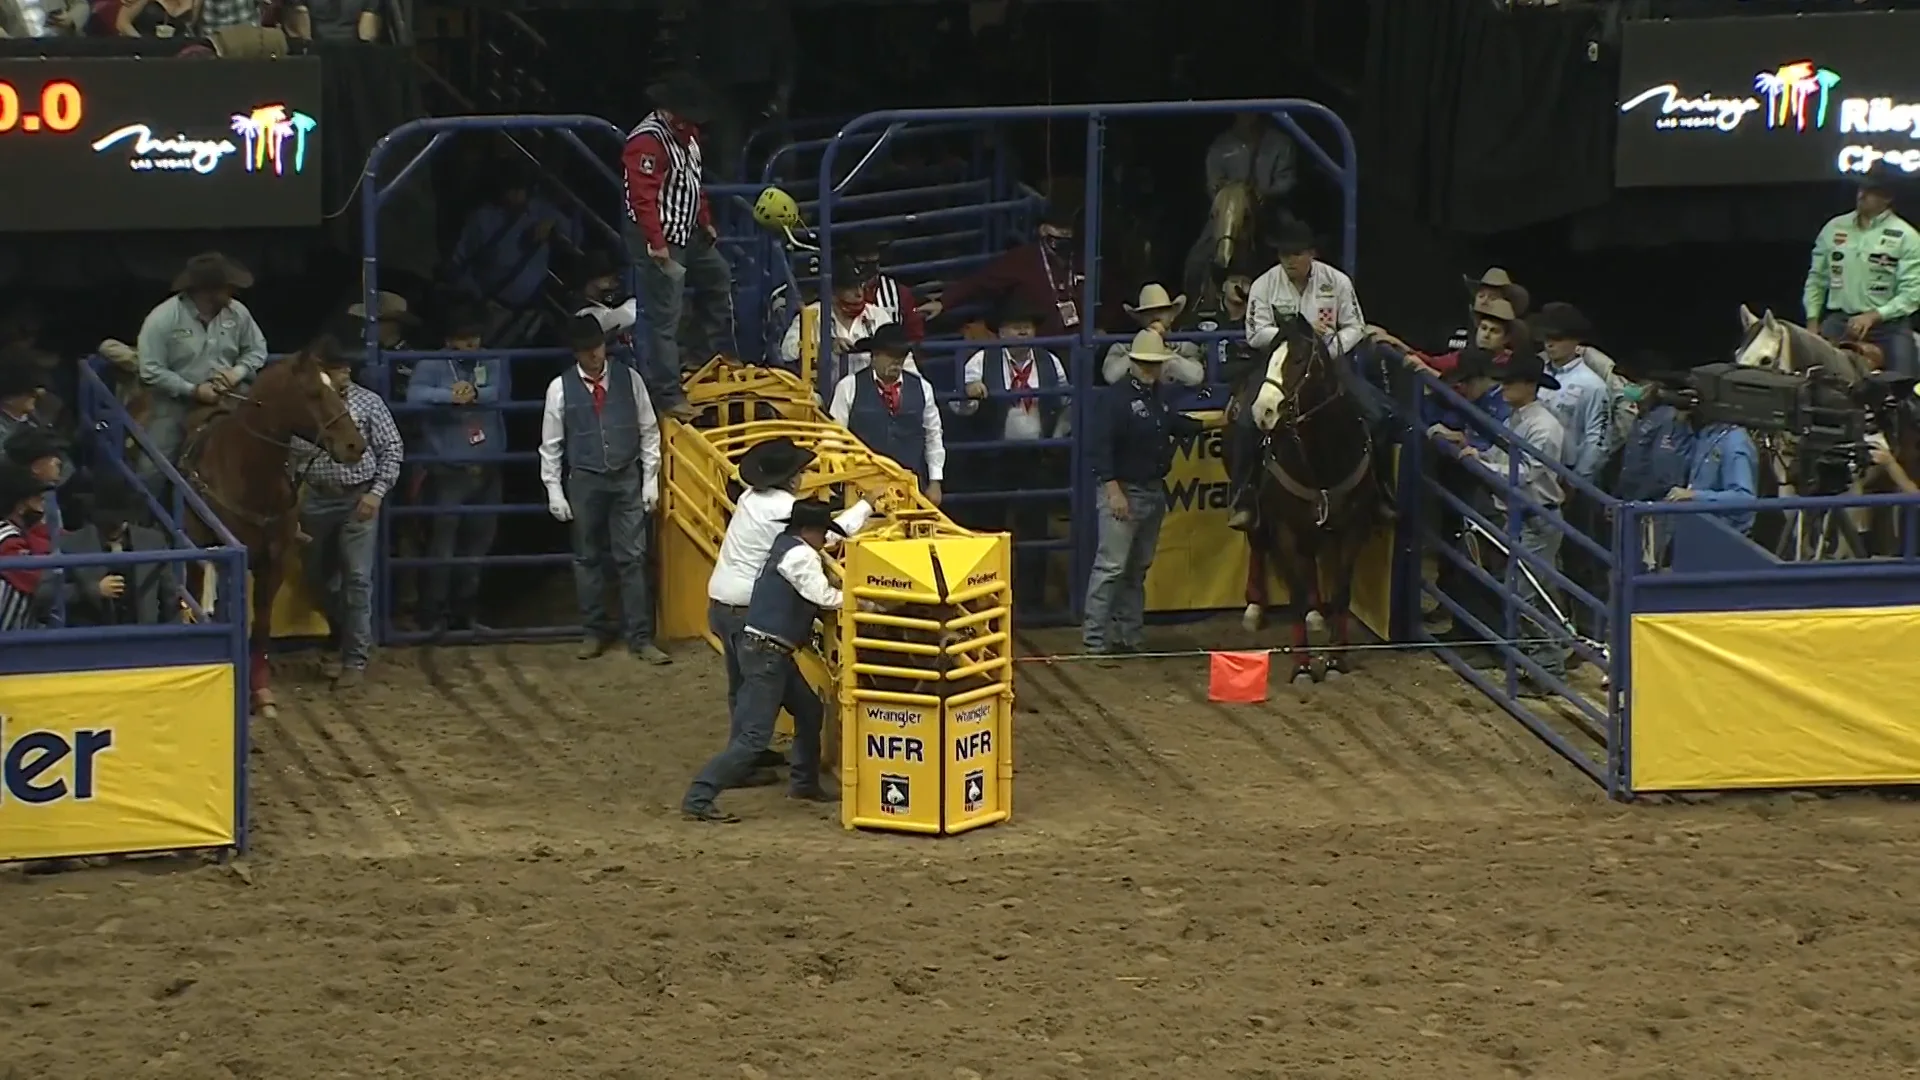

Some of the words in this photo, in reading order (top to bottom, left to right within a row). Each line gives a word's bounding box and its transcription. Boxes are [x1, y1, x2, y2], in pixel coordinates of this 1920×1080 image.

[866, 574, 913, 590] Priefert
[967, 571, 998, 586] Priefert
[866, 706, 922, 728] Wrangler
[955, 704, 991, 725] Wrangler
[867, 733, 924, 763] NFR
[955, 729, 992, 762] NFR
[0, 716, 113, 805] er
